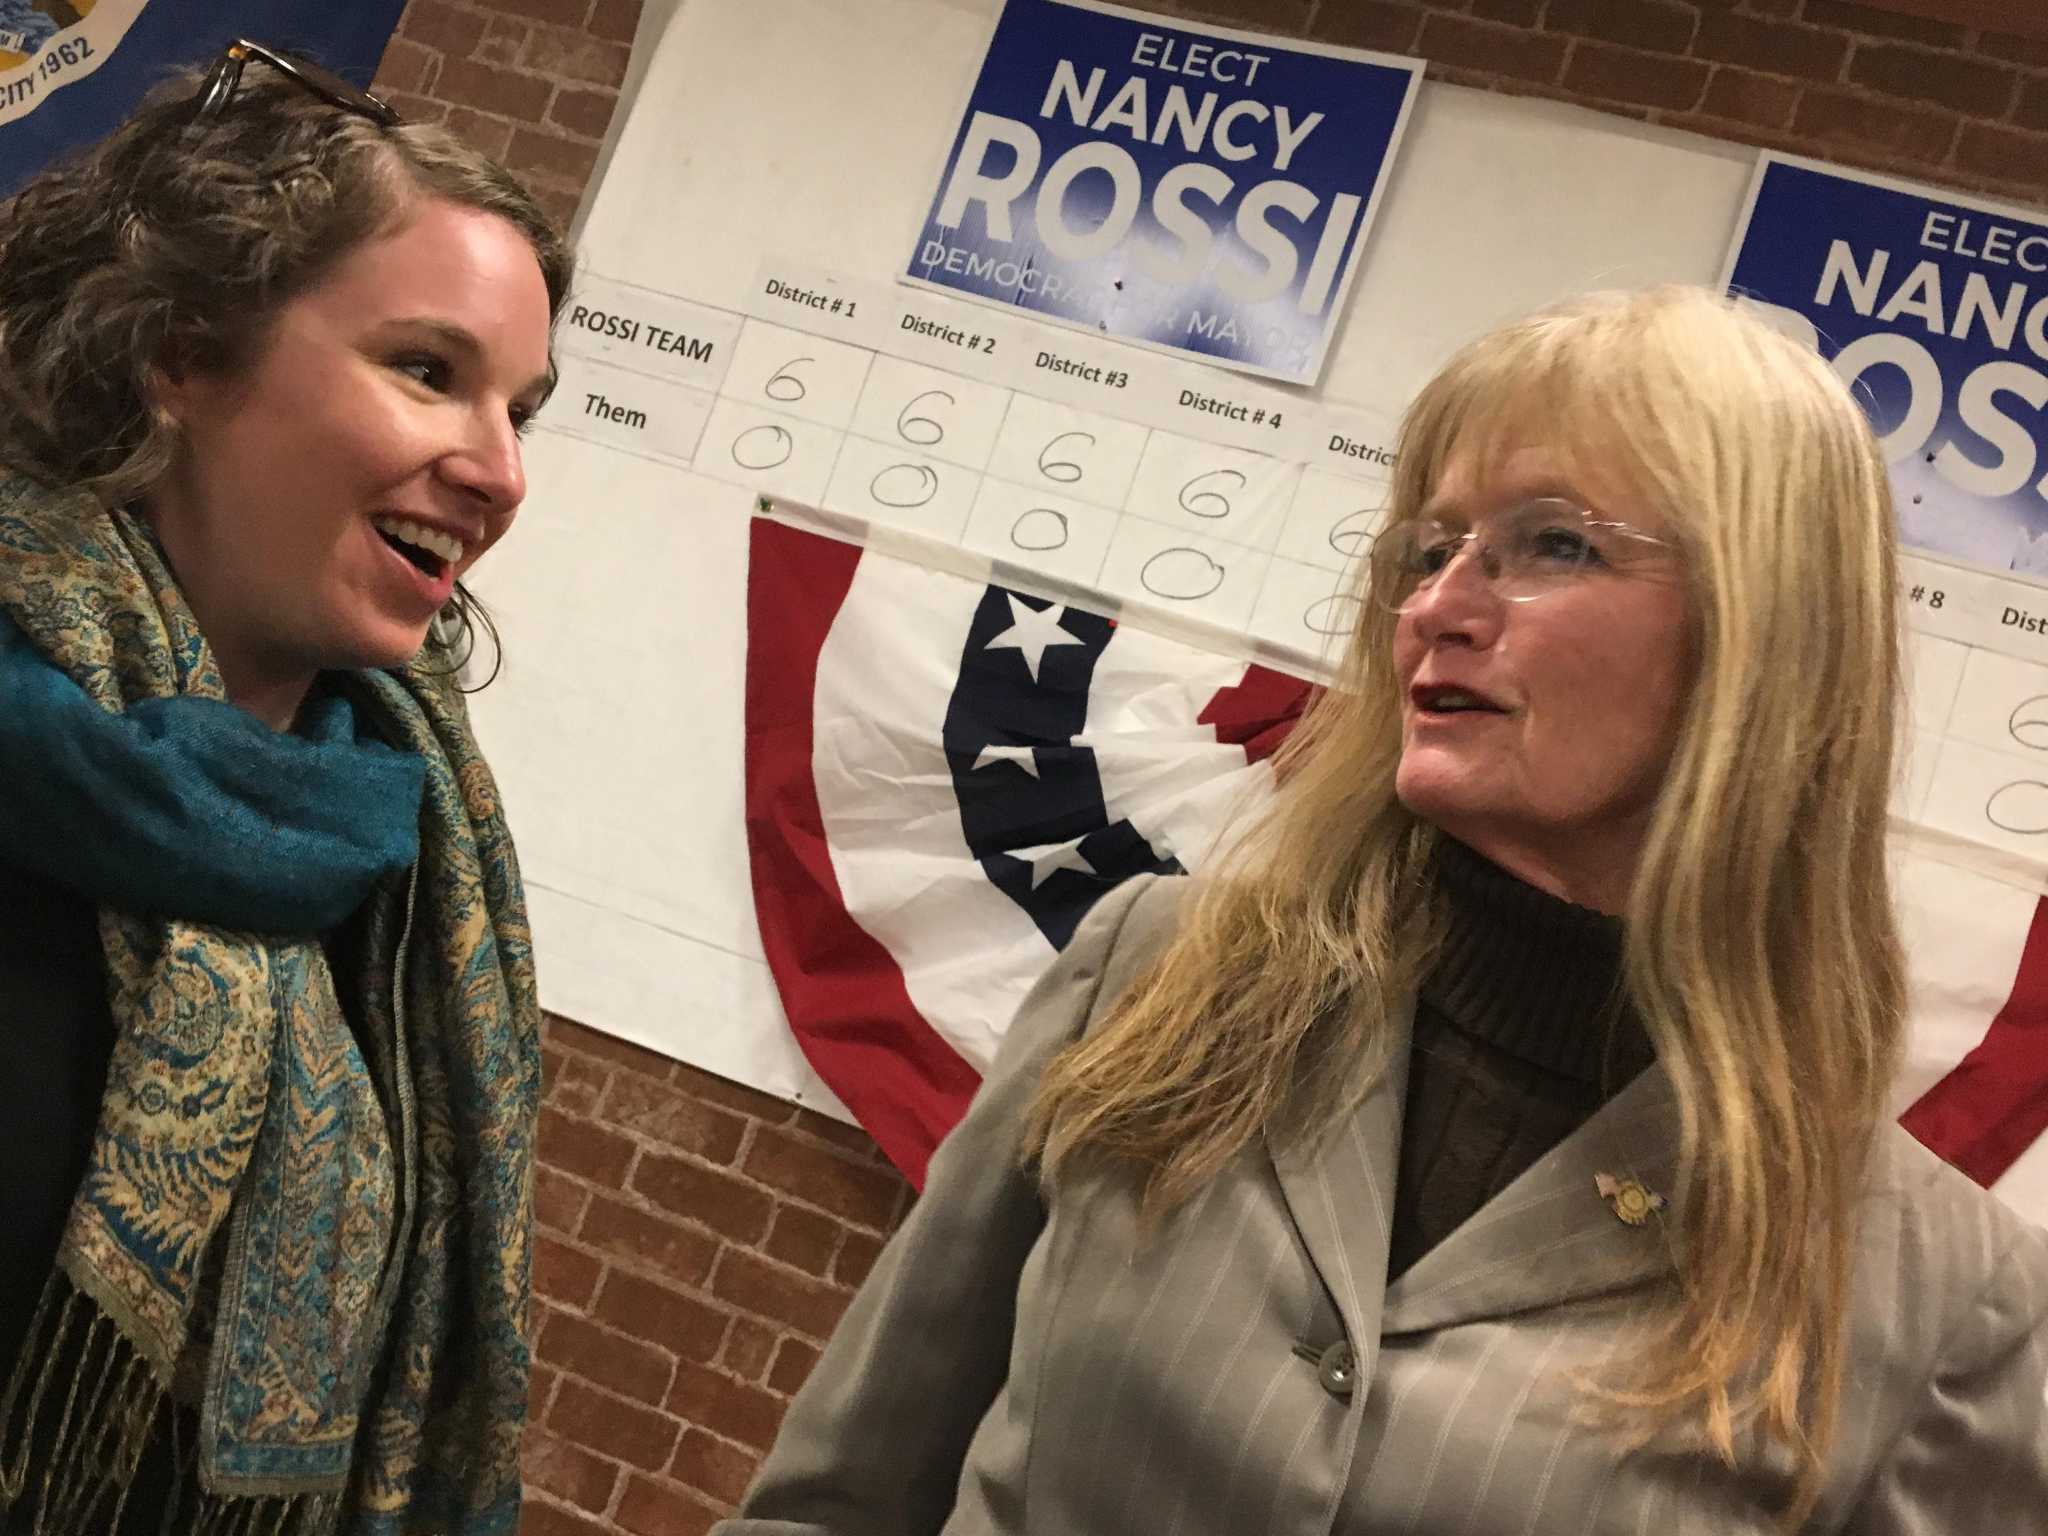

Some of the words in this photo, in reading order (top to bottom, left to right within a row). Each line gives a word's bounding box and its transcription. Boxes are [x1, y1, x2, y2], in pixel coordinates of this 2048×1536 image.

[38, 35, 96, 81] 1962
[1130, 33, 1269, 87] ELECT
[1040, 59, 1325, 170] NANCY
[936, 110, 1361, 315] ROSSI
[765, 279, 828, 310] District
[920, 240, 1102, 308] DEMOCRA
[570, 305, 640, 342] ROSSI
[646, 325, 714, 363] TEAM
[900, 314, 965, 346] District
[764, 357, 816, 402] 6
[1035, 351, 1102, 383] District
[1104, 370, 1129, 389] #3
[585, 393, 647, 429] Them
[896, 390, 955, 446] 6
[1178, 389, 1249, 422] District
[1037, 431, 1096, 484] 6
[1178, 469, 1247, 519] 6
